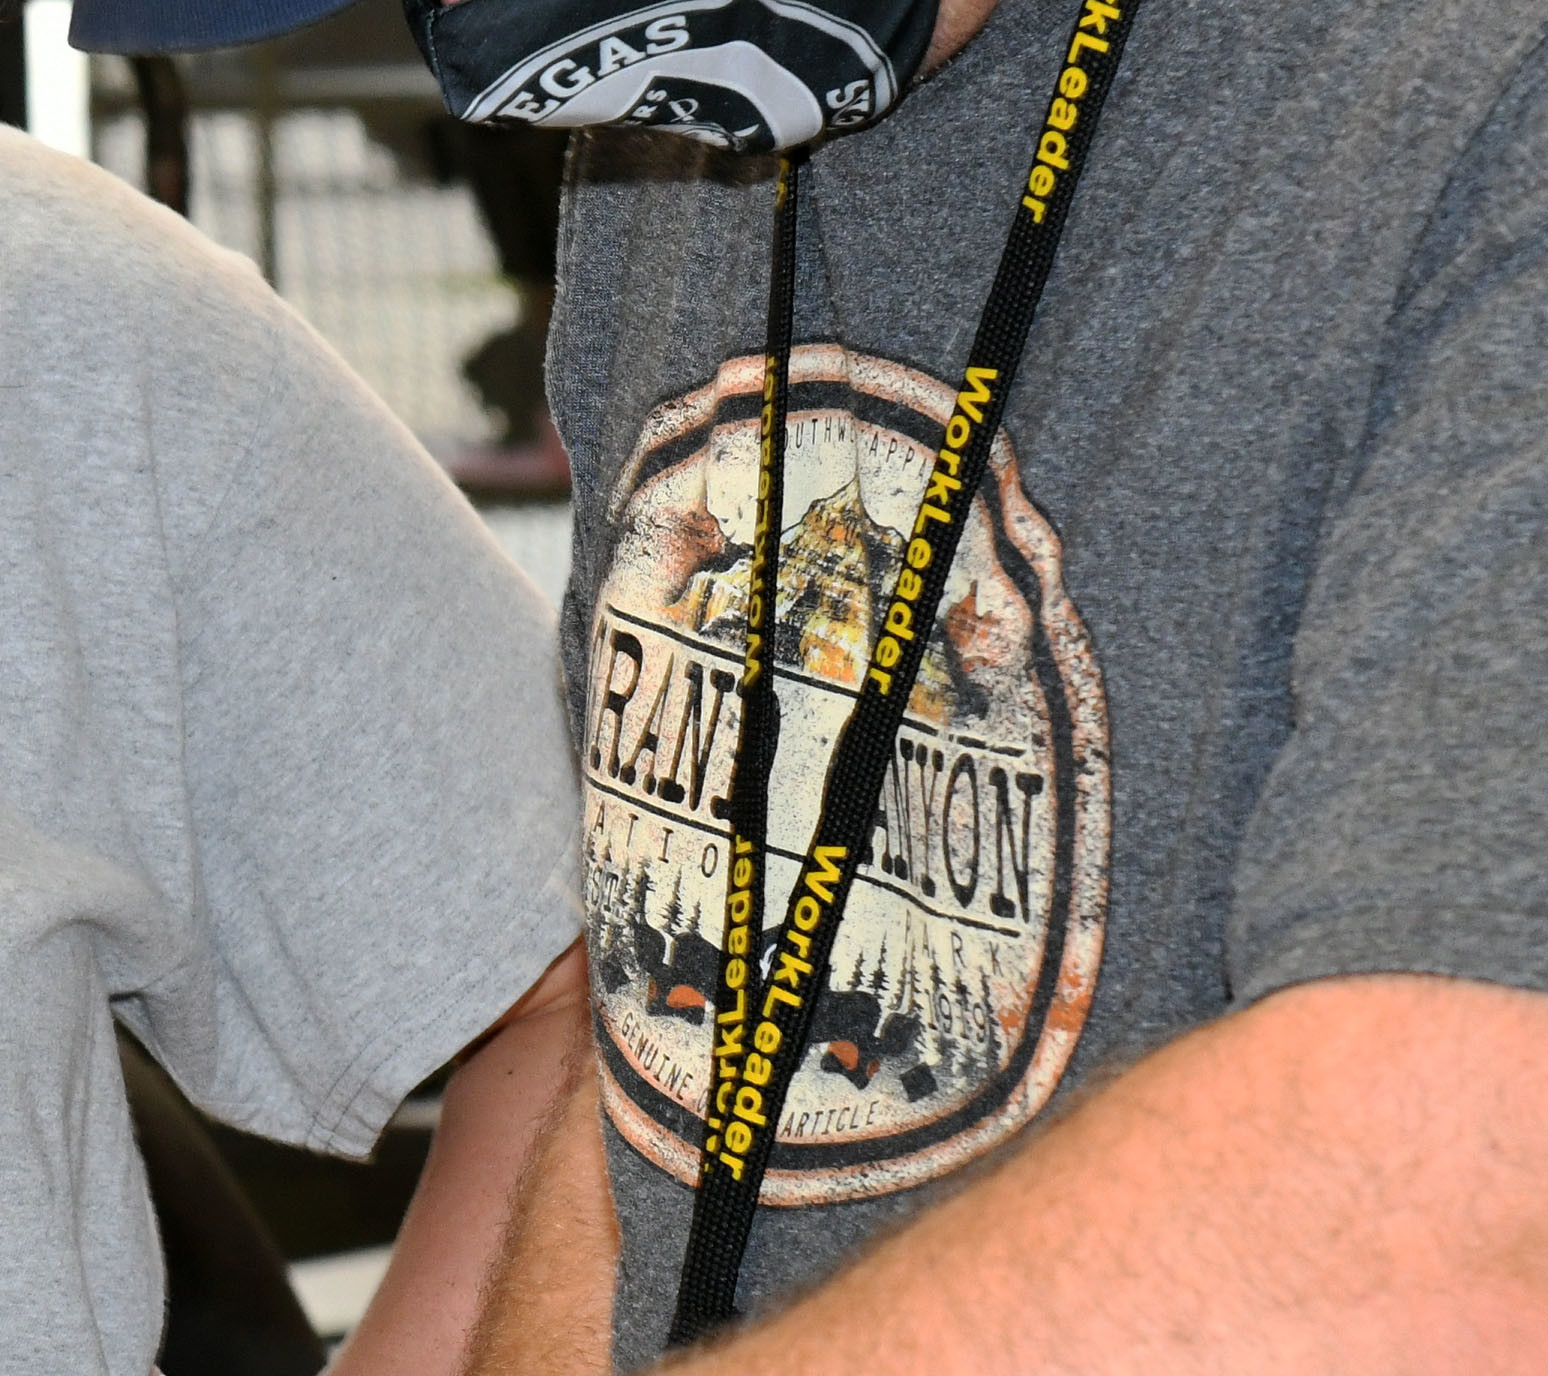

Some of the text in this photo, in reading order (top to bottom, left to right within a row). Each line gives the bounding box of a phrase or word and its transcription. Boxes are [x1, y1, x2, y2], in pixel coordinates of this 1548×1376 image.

[497, 15, 690, 123] EGAS
[868, 367, 999, 695] WorkLeader
[621, 1012, 693, 1101] GENUINE
[780, 1099, 879, 1137] ARTICLE
[719, 846, 849, 1181] WorkLeader
